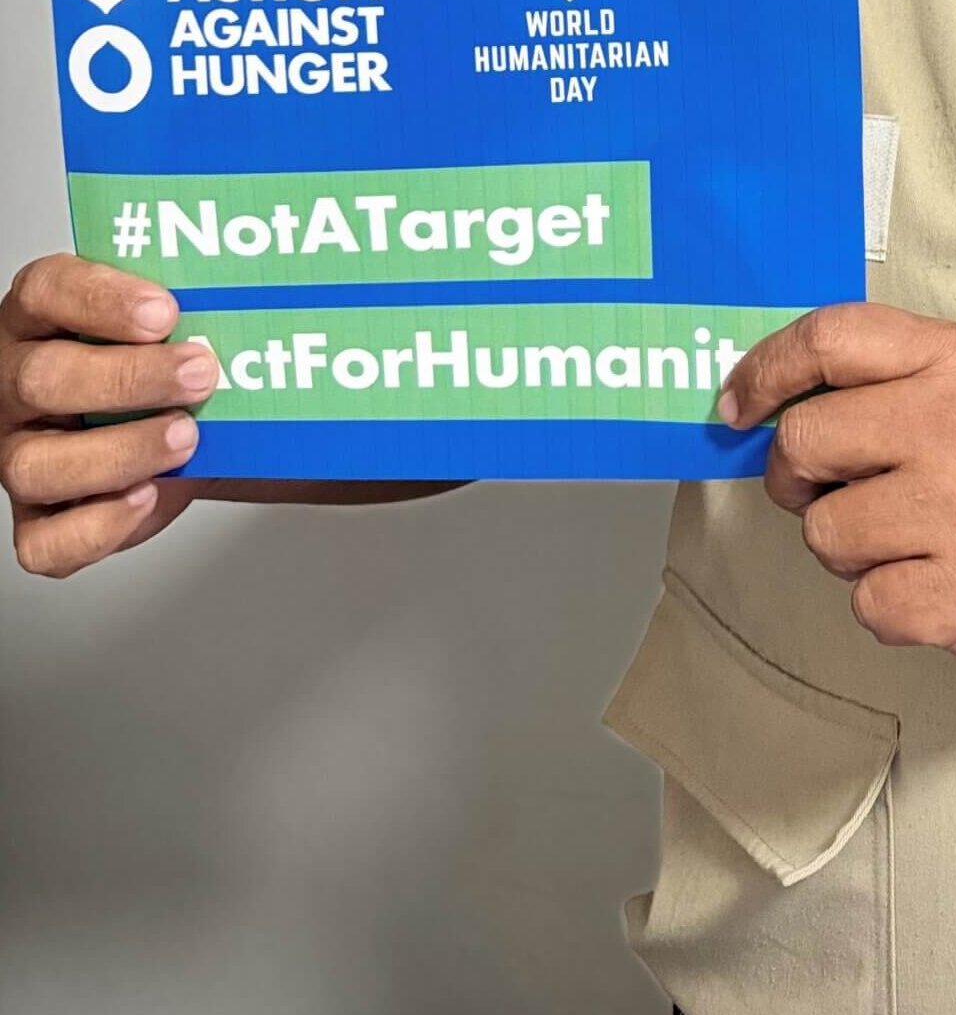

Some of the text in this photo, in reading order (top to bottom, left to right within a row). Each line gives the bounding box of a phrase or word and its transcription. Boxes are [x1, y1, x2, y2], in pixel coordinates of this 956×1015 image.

[170, 6, 385, 49] AGAINST
[526, 8, 615, 37] WORLD
[171, 52, 392, 96] HUNGER
[474, 40, 669, 72] HUMANITARIAN
[550, 76, 598, 103] DAY
[112, 193, 610, 266] #NotATarget
[187, 327, 747, 390] ctForHumanit
